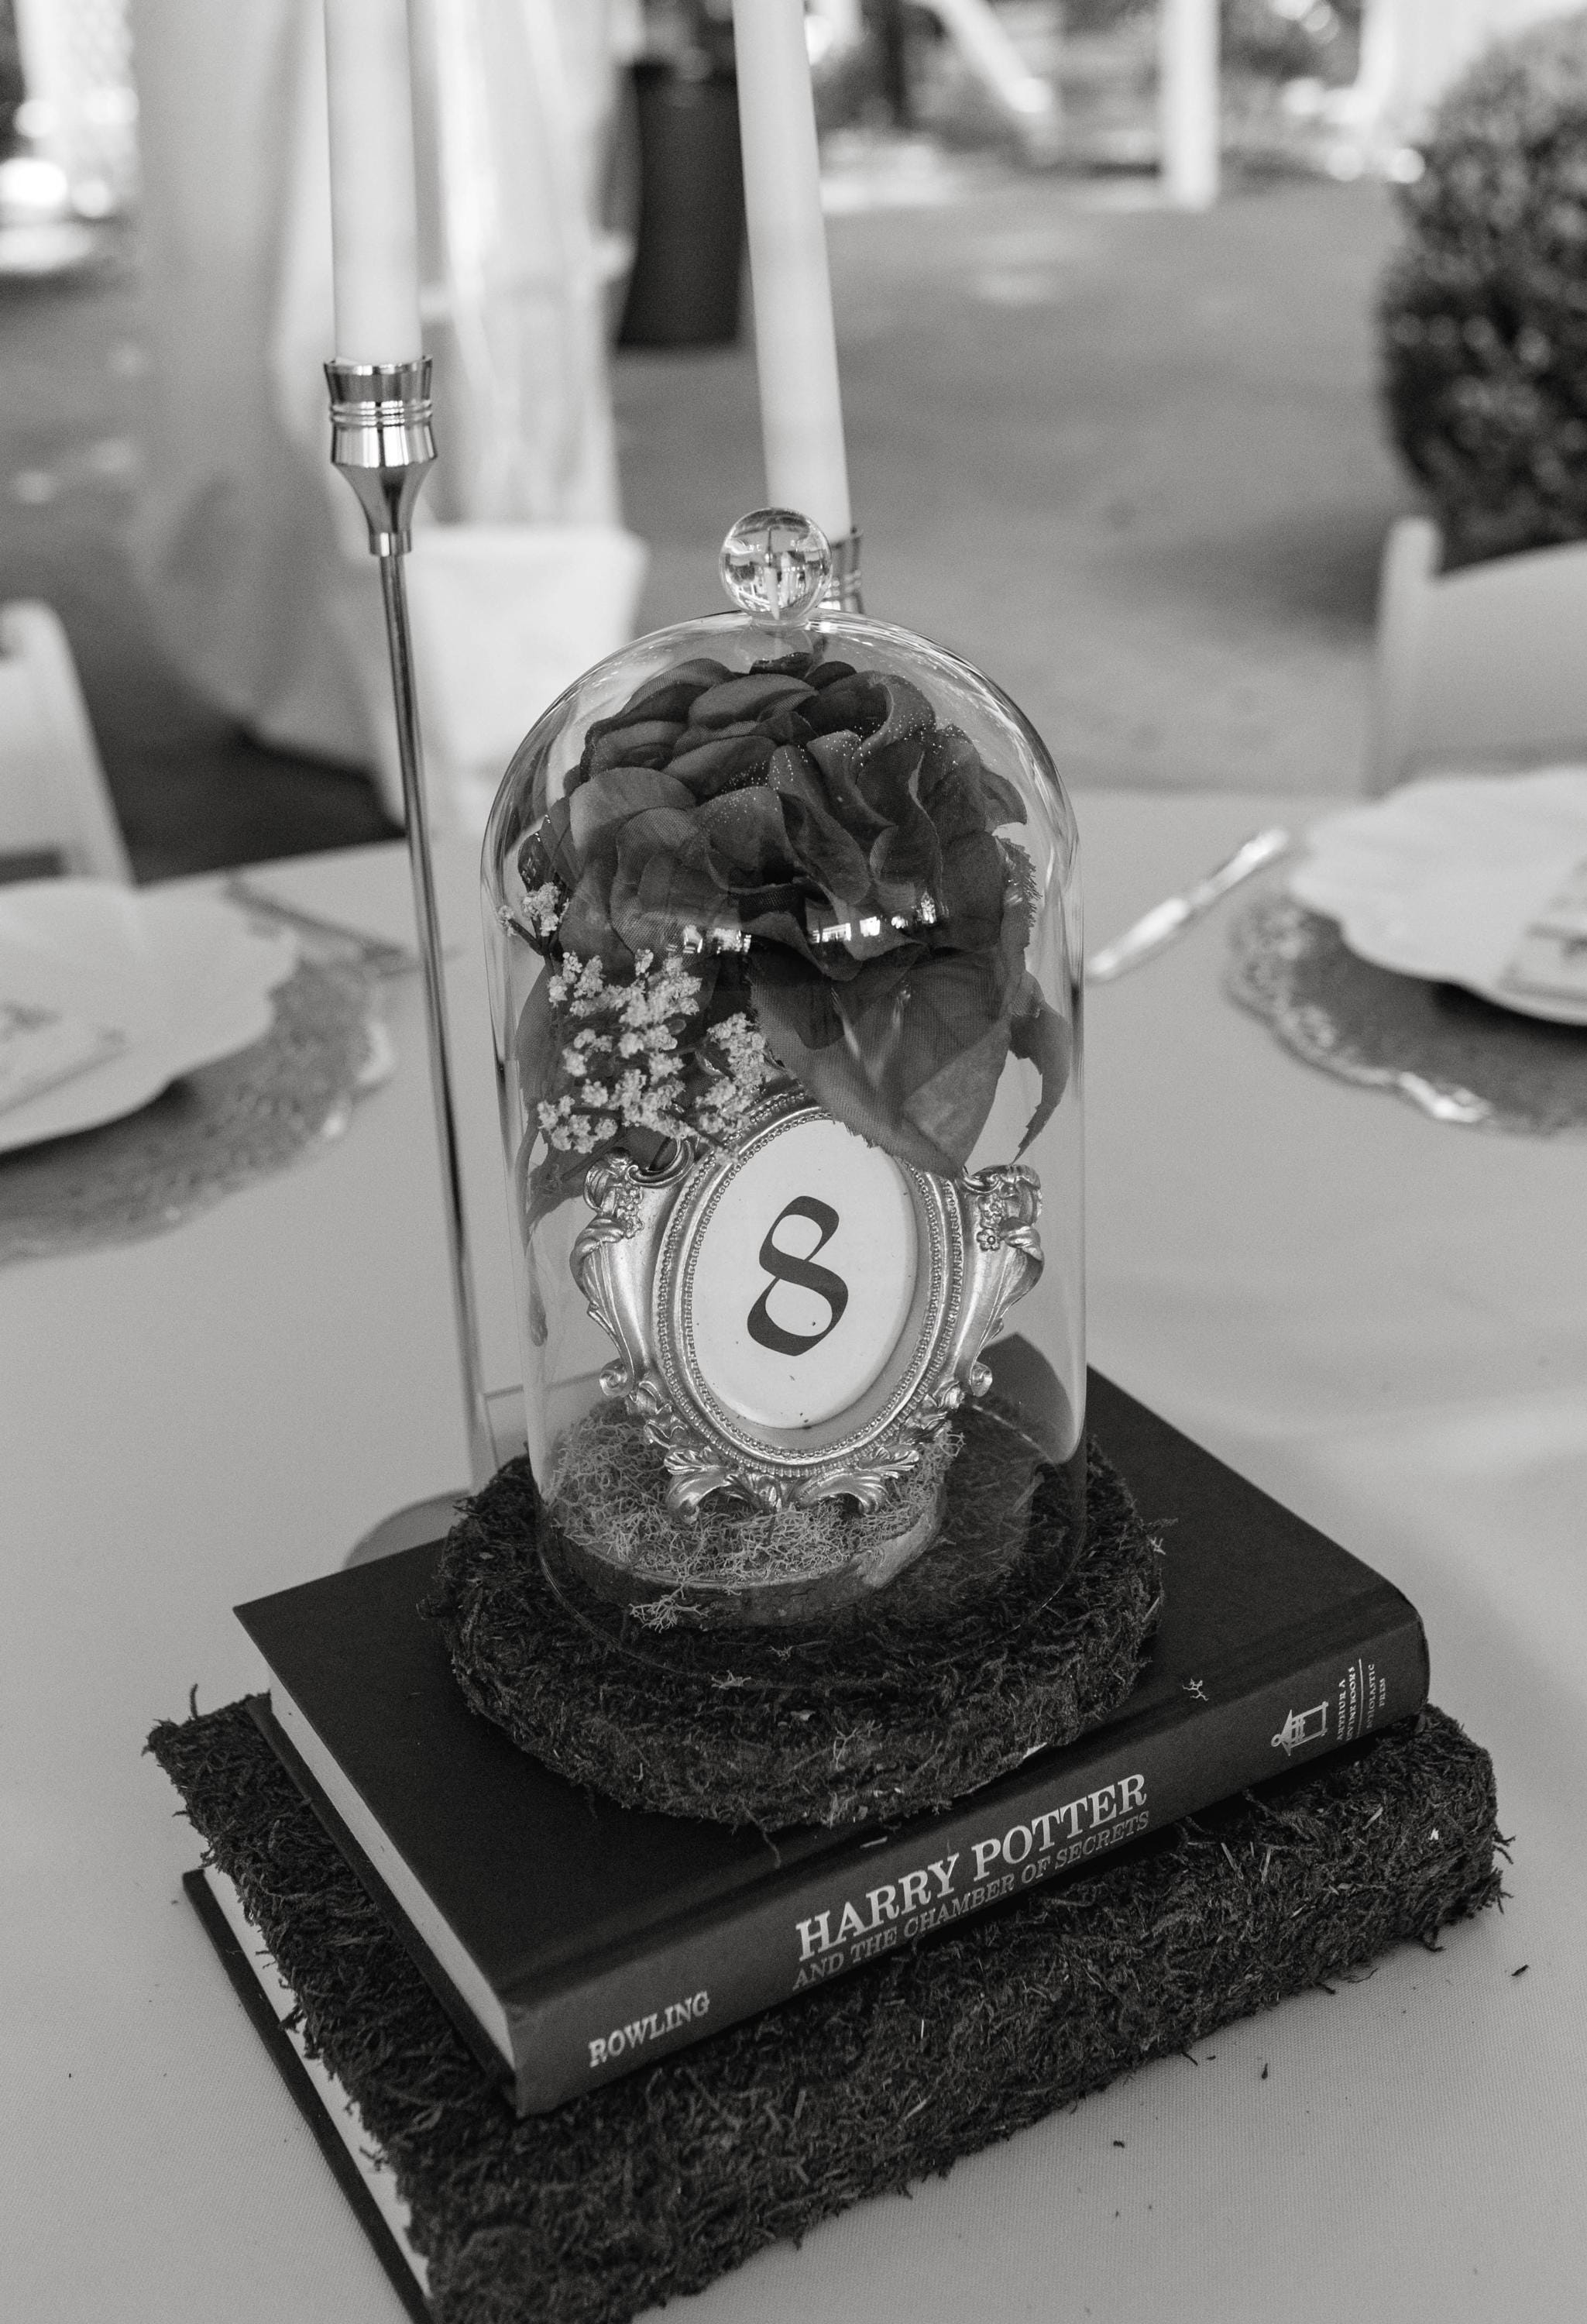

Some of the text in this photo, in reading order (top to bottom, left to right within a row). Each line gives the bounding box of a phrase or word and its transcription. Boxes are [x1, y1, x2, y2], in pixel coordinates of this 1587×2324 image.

[747, 1195, 848, 1356] 8
[1337, 1690, 1346, 1741] ARTHUR
[792, 1810, 1150, 1992] AND THE CHAMBER OF SECRETS
[795, 1773, 1147, 1962] HARRY POTTER
[589, 1990, 710, 2068] ROWLING
